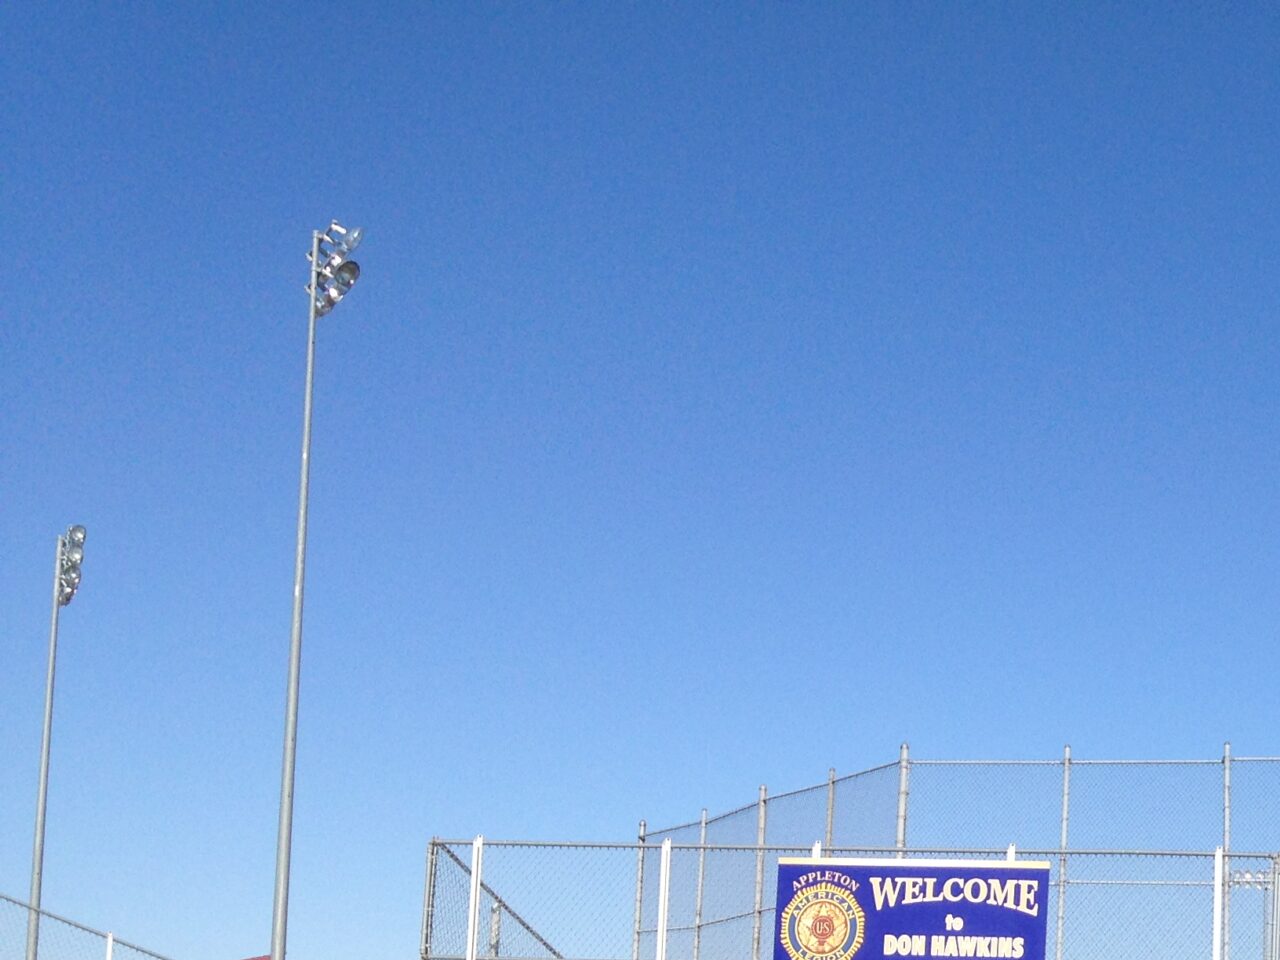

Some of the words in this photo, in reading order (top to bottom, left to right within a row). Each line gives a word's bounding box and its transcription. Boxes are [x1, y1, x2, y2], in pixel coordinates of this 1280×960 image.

[792, 870, 860, 892] APPLETON
[792, 891, 856, 919] AMERICAN
[869, 876, 1039, 917] WELCOME
[945, 914, 964, 931] to
[883, 934, 927, 956] DON
[930, 935, 1025, 959] HAWKINS
